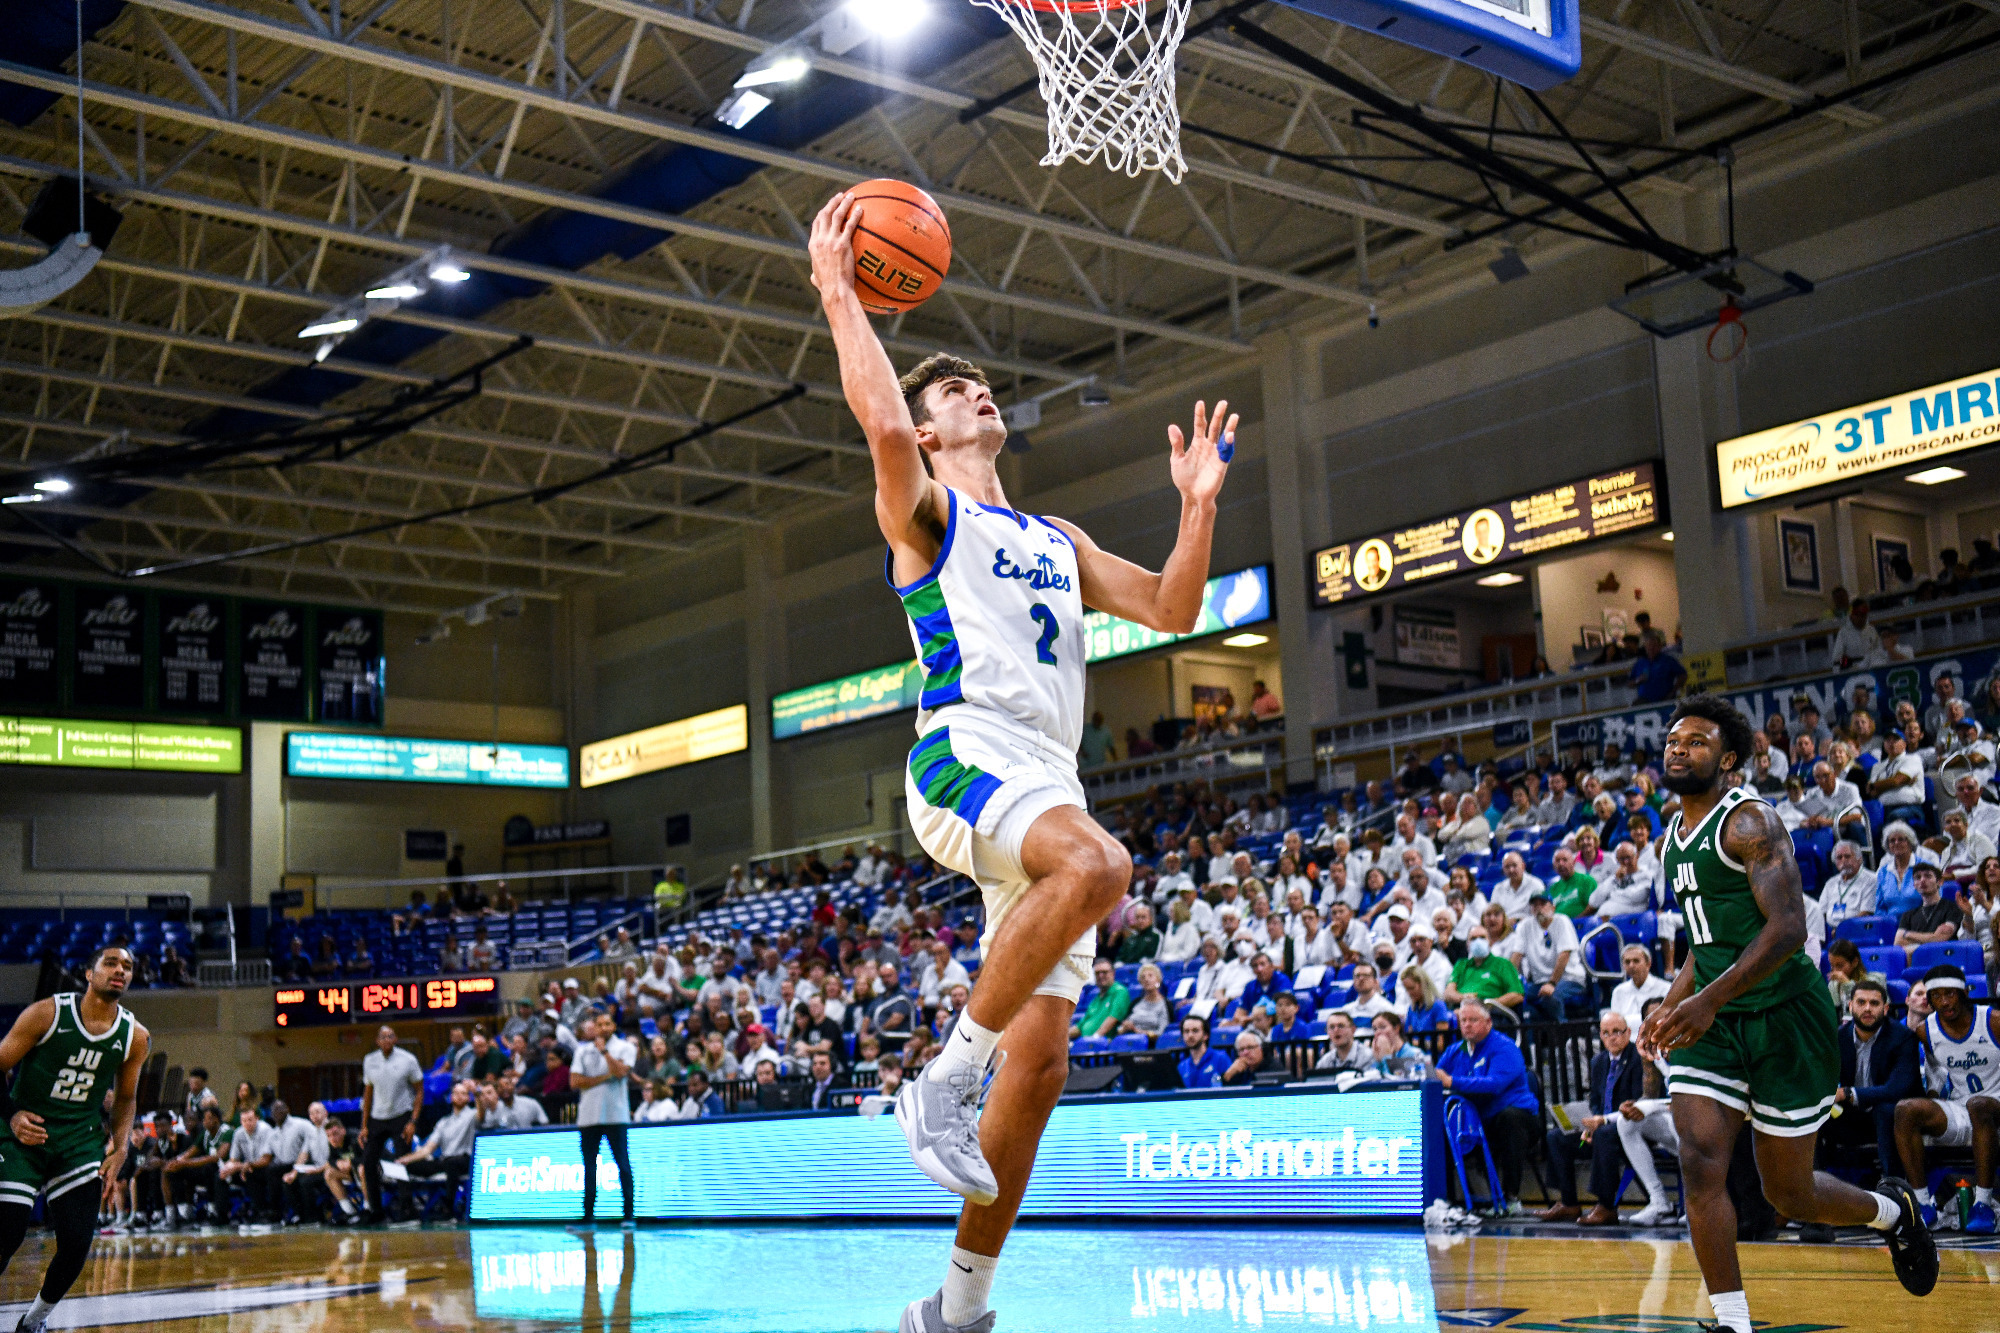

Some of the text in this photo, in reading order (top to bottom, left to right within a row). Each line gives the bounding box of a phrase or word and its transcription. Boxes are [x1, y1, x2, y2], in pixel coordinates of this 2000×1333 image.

[857, 250, 923, 295] ELITE
[1834, 406, 1892, 454] 3T
[1732, 441, 1811, 474] PROSCAN
[1837, 422, 2000, 472] WWW.PROSCAN.CO
[1588, 470, 1637, 496] Premier
[1754, 456, 1828, 485] imaging
[1029, 602, 1060, 667] 2
[1673, 862, 1698, 893] JU
[1684, 895, 1713, 945] 11
[318, 987, 349, 1013] 44
[426, 980, 457, 1009] 53
[67, 1047, 103, 1070] JU
[1947, 1050, 1989, 1070] Eagles
[50, 1068, 95, 1102] 22
[1966, 1072, 1984, 1094] 0
[1119, 1127, 1413, 1180] TicketSmarter
[480, 1153, 621, 1193] TicketSmate
